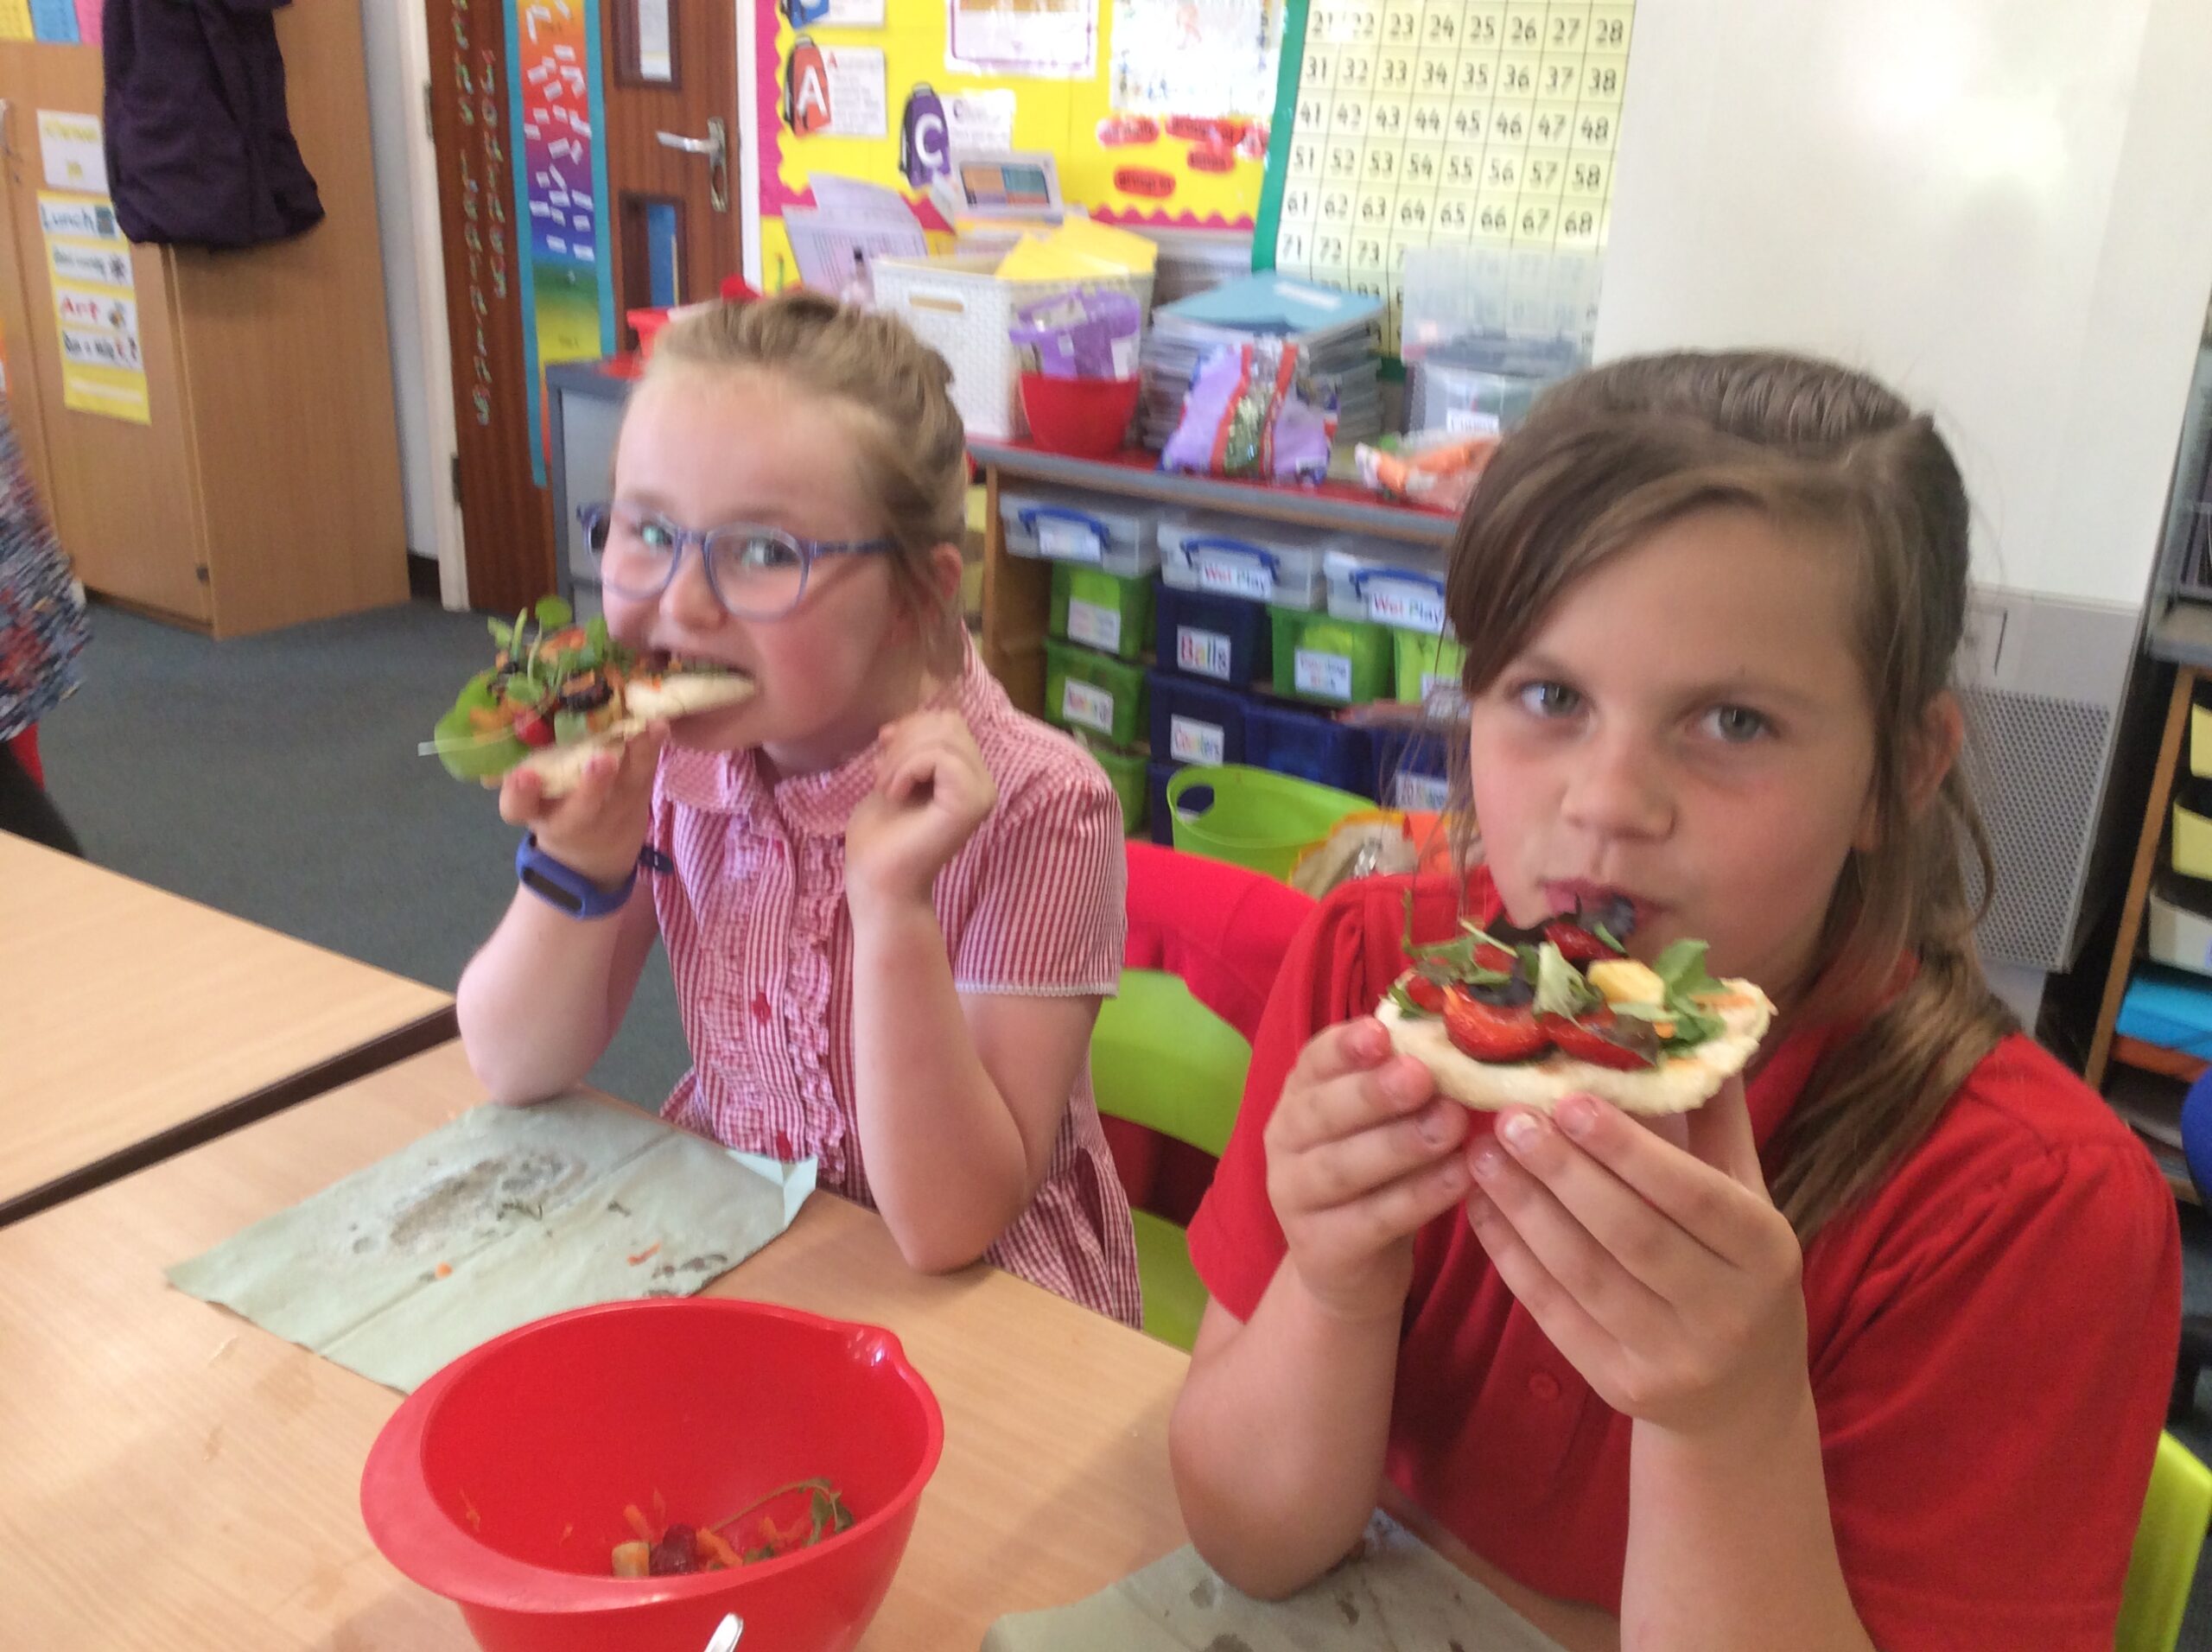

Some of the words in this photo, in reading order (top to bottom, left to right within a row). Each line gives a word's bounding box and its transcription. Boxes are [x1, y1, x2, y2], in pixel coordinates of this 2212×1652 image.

[1312, 10, 1332, 37] 21
[1351, 12, 1374, 38] 22
[1389, 12, 1414, 39] 23
[1429, 14, 1454, 41] 24
[1470, 16, 1496, 42] 25
[1511, 16, 1537, 43] 26
[1553, 17, 1580, 45] 27
[1595, 19, 1624, 48] 28
[796, 65, 829, 118] A
[1306, 54, 1327, 79] 31
[1344, 57, 1368, 85] 32
[1382, 58, 1407, 85] 33
[1422, 60, 1448, 87] 34
[1463, 63, 1488, 88] 35
[1503, 64, 1529, 91] 36
[1545, 67, 1573, 92] 37
[1591, 67, 1617, 95] 38
[913, 112, 944, 167] C
[1300, 100, 1321, 125] 41
[1337, 103, 1361, 128] 42
[1376, 105, 1400, 131] 43
[1415, 107, 1440, 134] 44
[1456, 110, 1480, 137] 45
[1497, 112, 1522, 138] 46
[1538, 114, 1566, 140] 47
[1581, 116, 1610, 143] 48
[1294, 147, 1314, 171] 51
[1331, 148, 1355, 174] 52
[1369, 150, 1393, 175] 53
[1408, 153, 1433, 180] 54
[1450, 156, 1473, 182] 55
[1491, 157, 1514, 186] 56
[1531, 160, 1558, 187] 57
[1574, 162, 1600, 190] 58
[41, 204, 97, 235] Lunch
[1288, 191, 1307, 217] 61
[1325, 193, 1348, 219] 62
[1362, 196, 1385, 223] 63
[1402, 198, 1425, 226] 64
[1440, 201, 1465, 228] 65
[1481, 204, 1507, 231] 66
[1522, 208, 1550, 236] 67
[1565, 211, 1592, 238] 68
[1282, 233, 1301, 259] 71
[1319, 236, 1342, 264] 72
[1357, 239, 1380, 268] 73
[64, 295, 99, 323] Art
[1236, 568, 1269, 595] Play
[1408, 598, 1444, 627] Play
[1180, 633, 1228, 676] Balls
